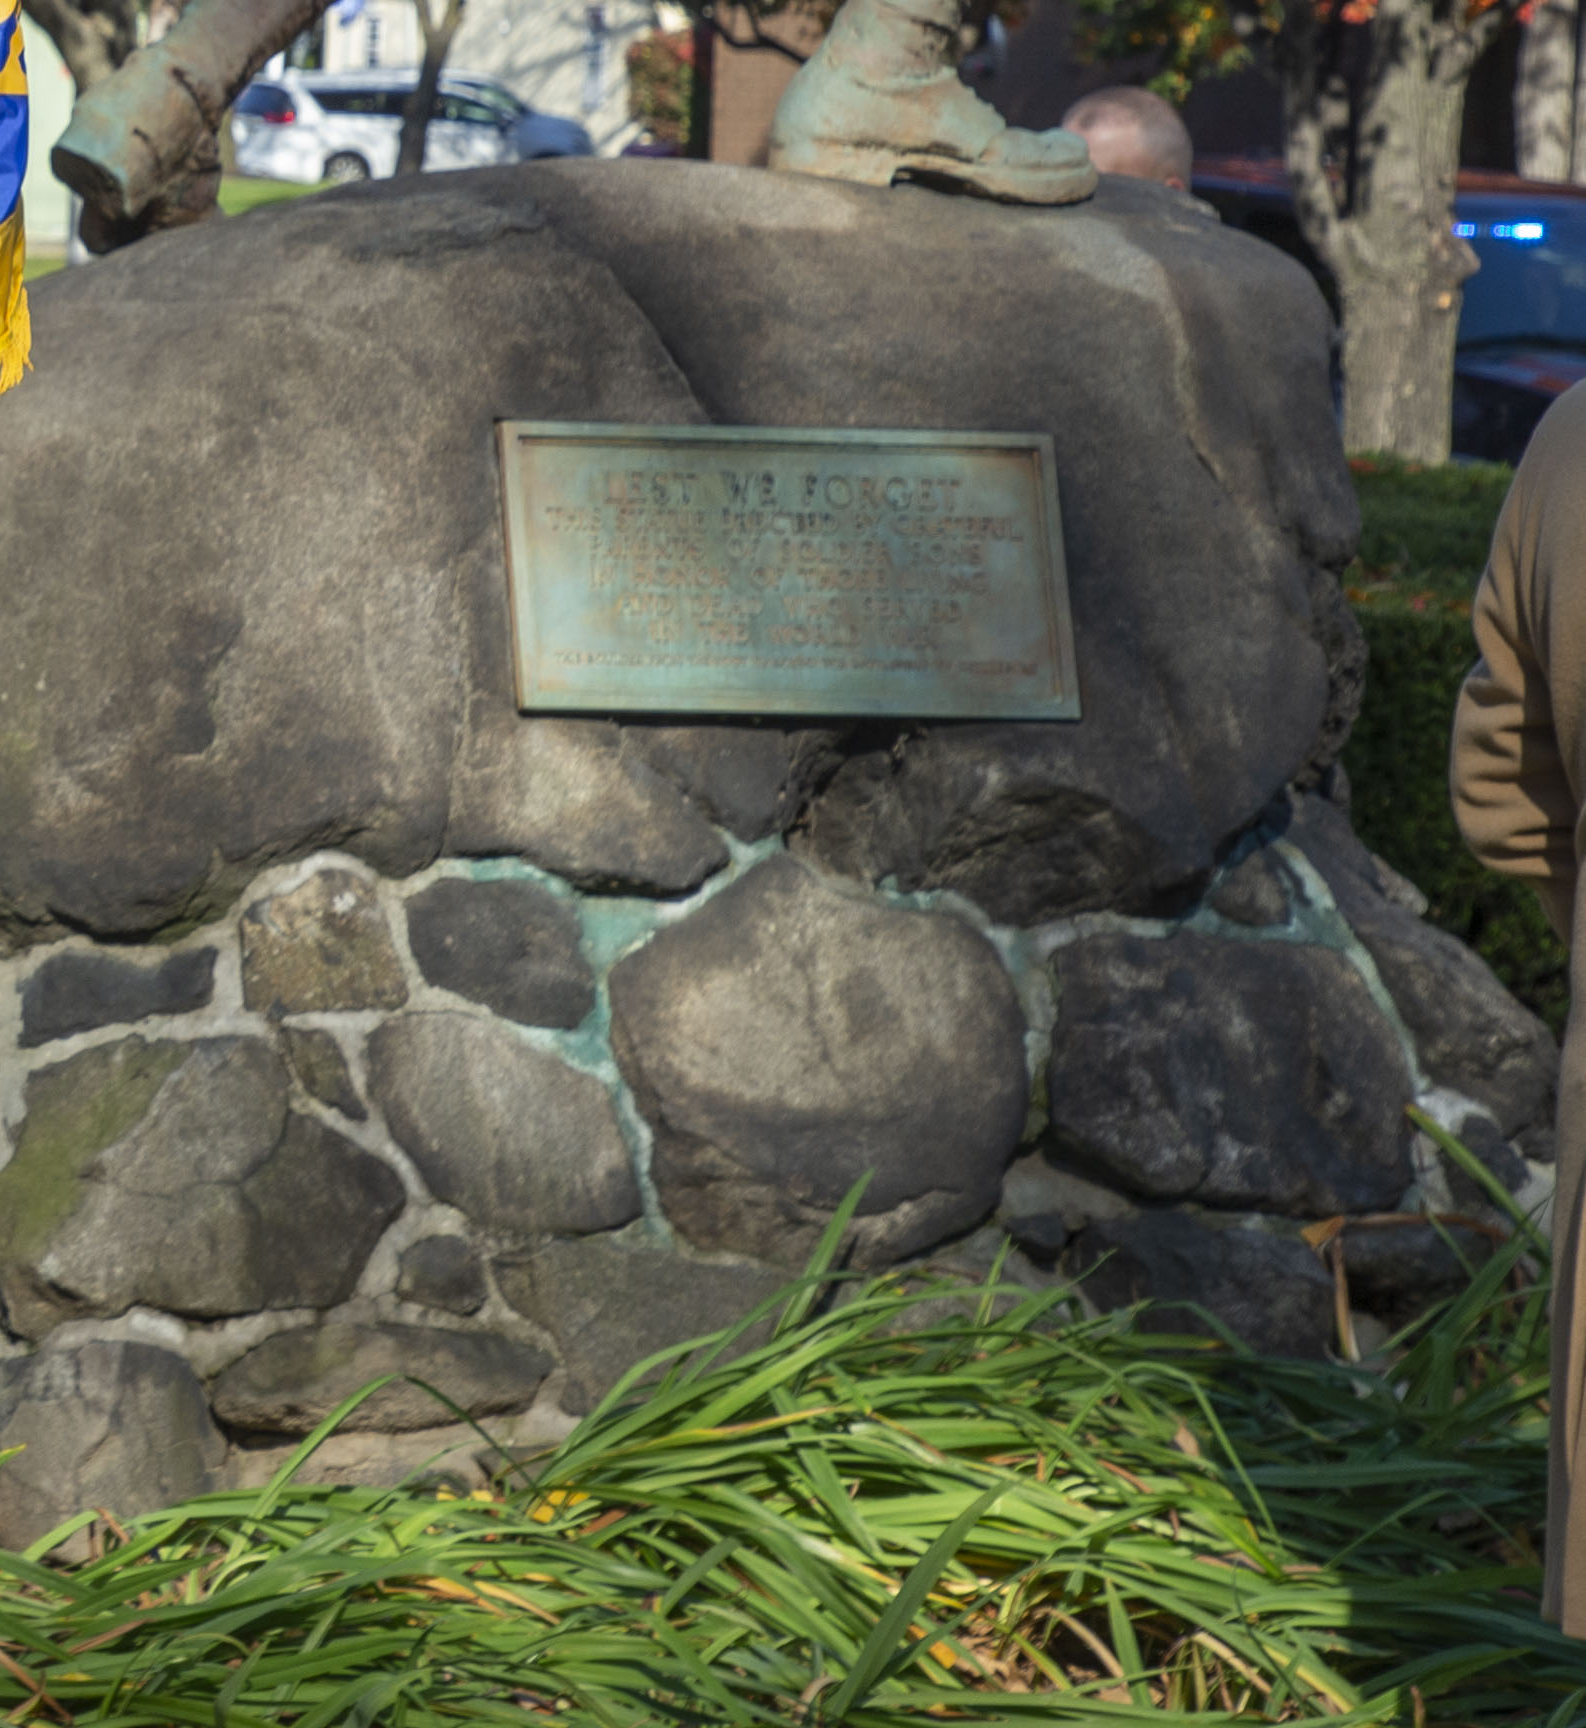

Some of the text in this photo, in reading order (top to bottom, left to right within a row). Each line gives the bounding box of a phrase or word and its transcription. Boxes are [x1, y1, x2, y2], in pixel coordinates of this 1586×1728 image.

[603, 470, 961, 512] LEST WE FORGET
